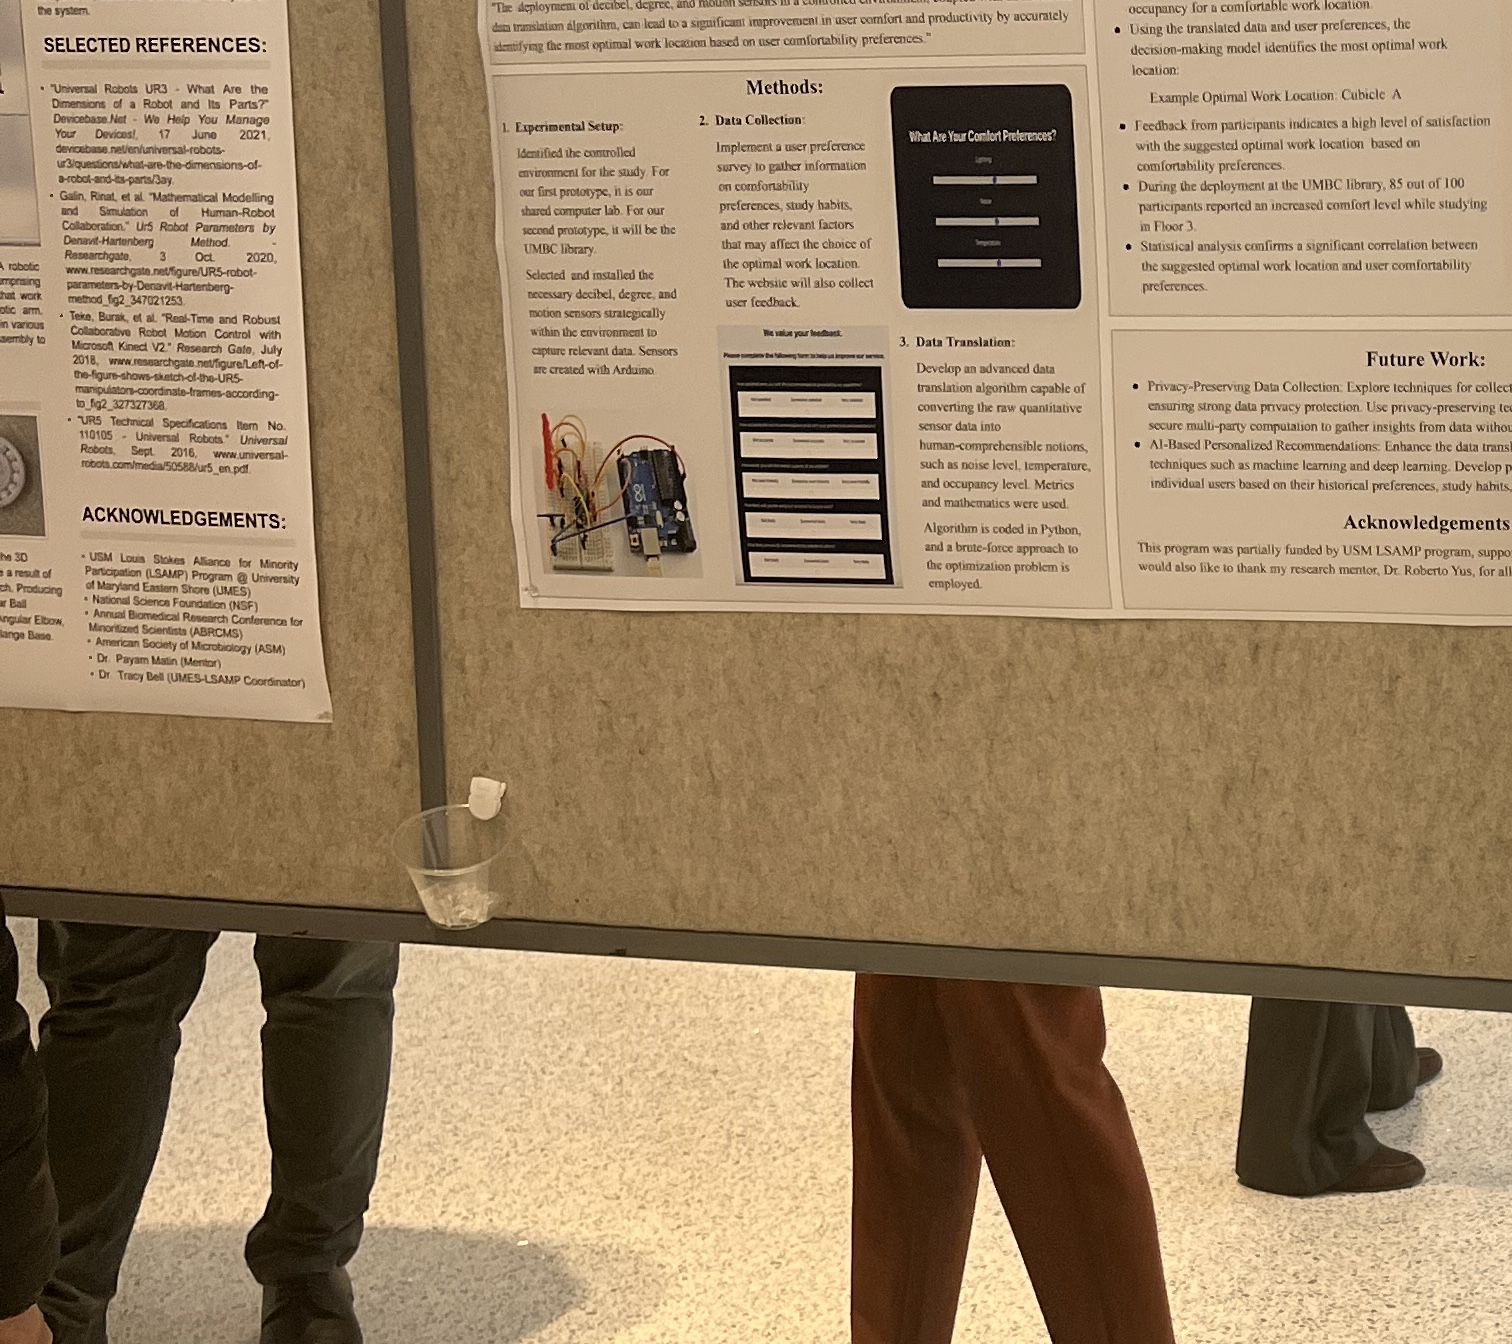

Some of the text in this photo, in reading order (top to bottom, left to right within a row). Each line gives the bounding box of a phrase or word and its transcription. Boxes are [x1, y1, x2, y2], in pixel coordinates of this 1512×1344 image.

[43, 36, 267, 53] SELECTED REFERENCES:
[745, 78, 823, 95] Methods:
[1149, 91, 1200, 106] Example
[1201, 90, 1248, 106] Optimal
[1250, 90, 1282, 102] Work
[1341, 88, 1386, 101] Cubicle
[1391, 88, 1402, 100] A
[515, 120, 586, 135] Experimental
[587, 120, 624, 134] Setup:
[698, 113, 805, 126] 2. Data Collection:
[932, 129, 947, 143] Are
[947, 130, 967, 142] Your
[967, 129, 1002, 142] Comfort
[1002, 129, 1057, 142] Preferences?
[715, 139, 866, 155] Implement a user preference
[1139, 223, 1151, 232] in
[1153, 219, 1184, 232] Floor
[522, 242, 558, 255] UMBC
[915, 335, 943, 347] Data
[945, 336, 1015, 347] Translation:
[1366, 350, 1485, 367] Future Work:
[916, 361, 1055, 377] Develop an advanced data
[82, 506, 286, 529] ACKNOWLEDGEMENTS:
[92, 593, 258, 613] National Science Foundation (NSF)
[115, 653, 150, 666] Payam
[150, 655, 178, 666] Matin
[179, 656, 222, 669] (Mentor)
